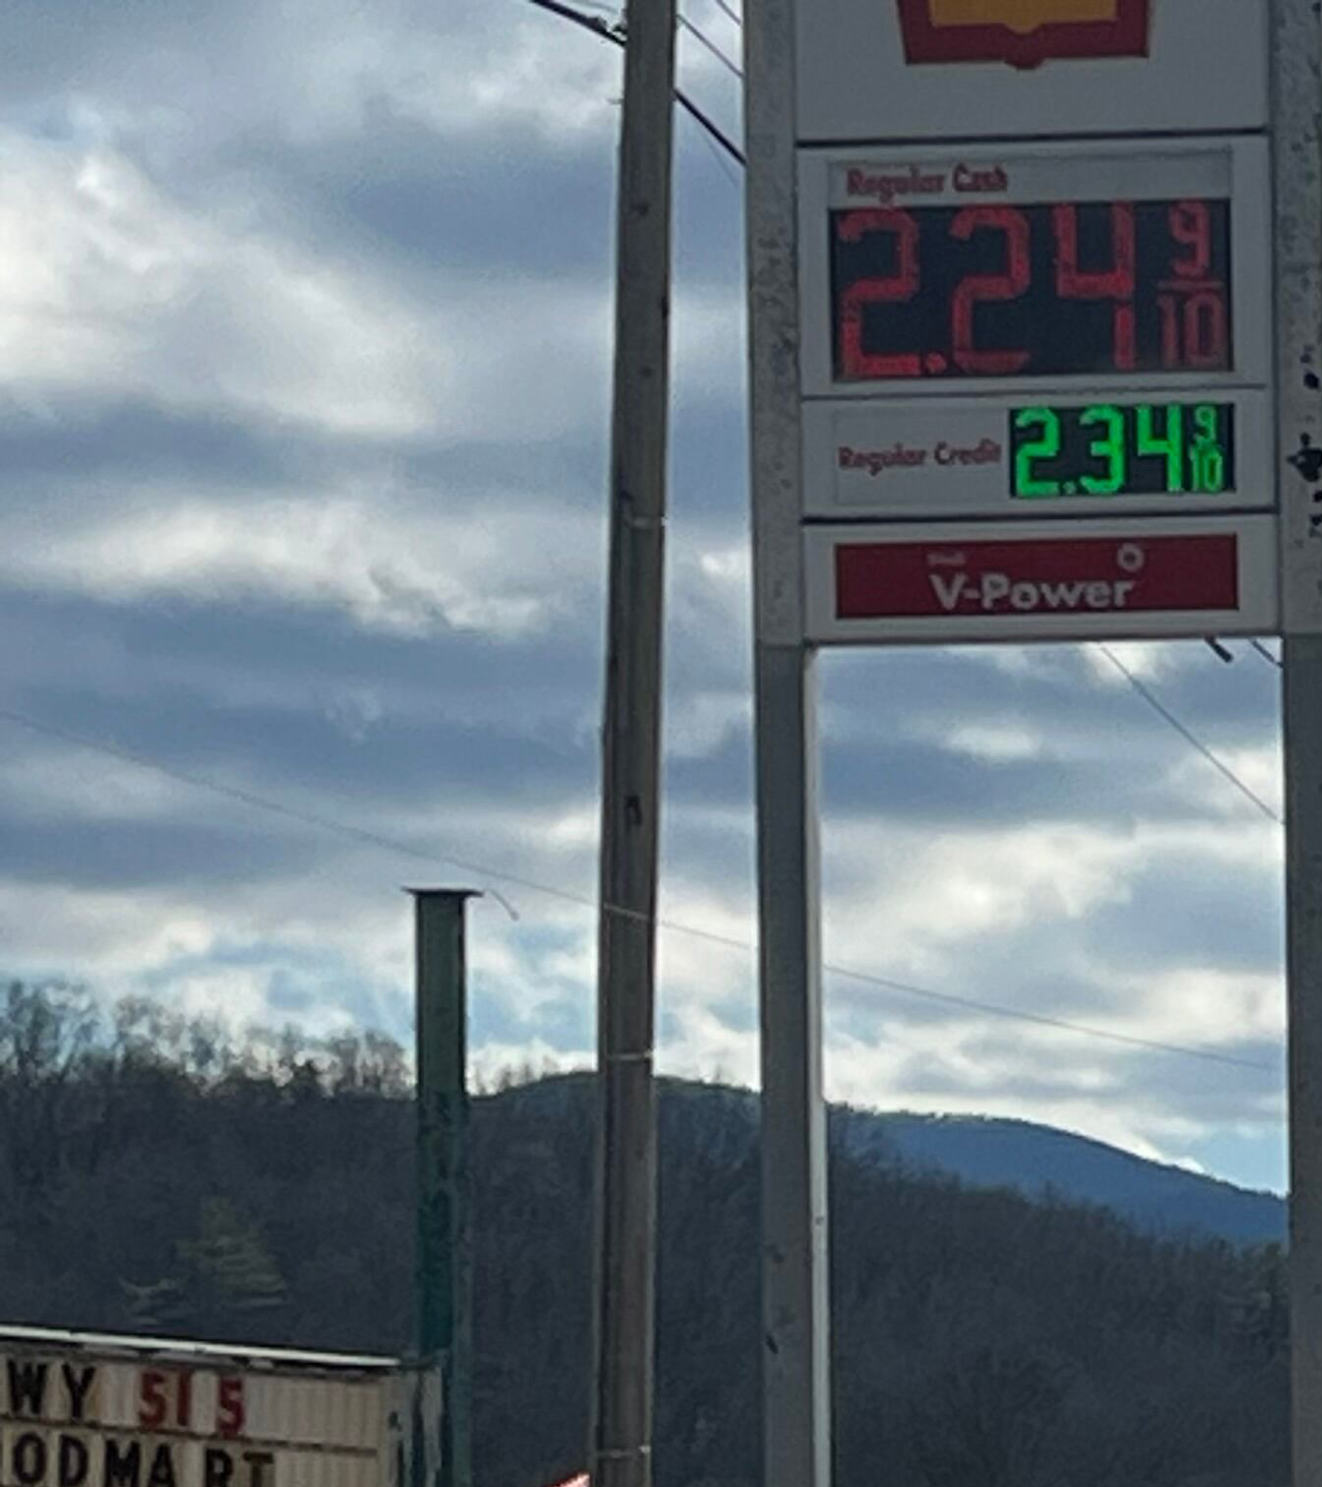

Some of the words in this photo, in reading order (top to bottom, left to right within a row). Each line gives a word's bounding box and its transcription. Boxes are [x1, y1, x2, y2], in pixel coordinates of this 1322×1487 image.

[846, 165, 944, 202] Regular
[952, 162, 1008, 191] Cash
[837, 201, 1136, 376] 2.24
[838, 443, 926, 475] Regular
[934, 438, 999, 466] Credit
[1015, 404, 1184, 496] 2.34
[928, 572, 1137, 610] V-Power
[138, 1367, 246, 1438] 515
